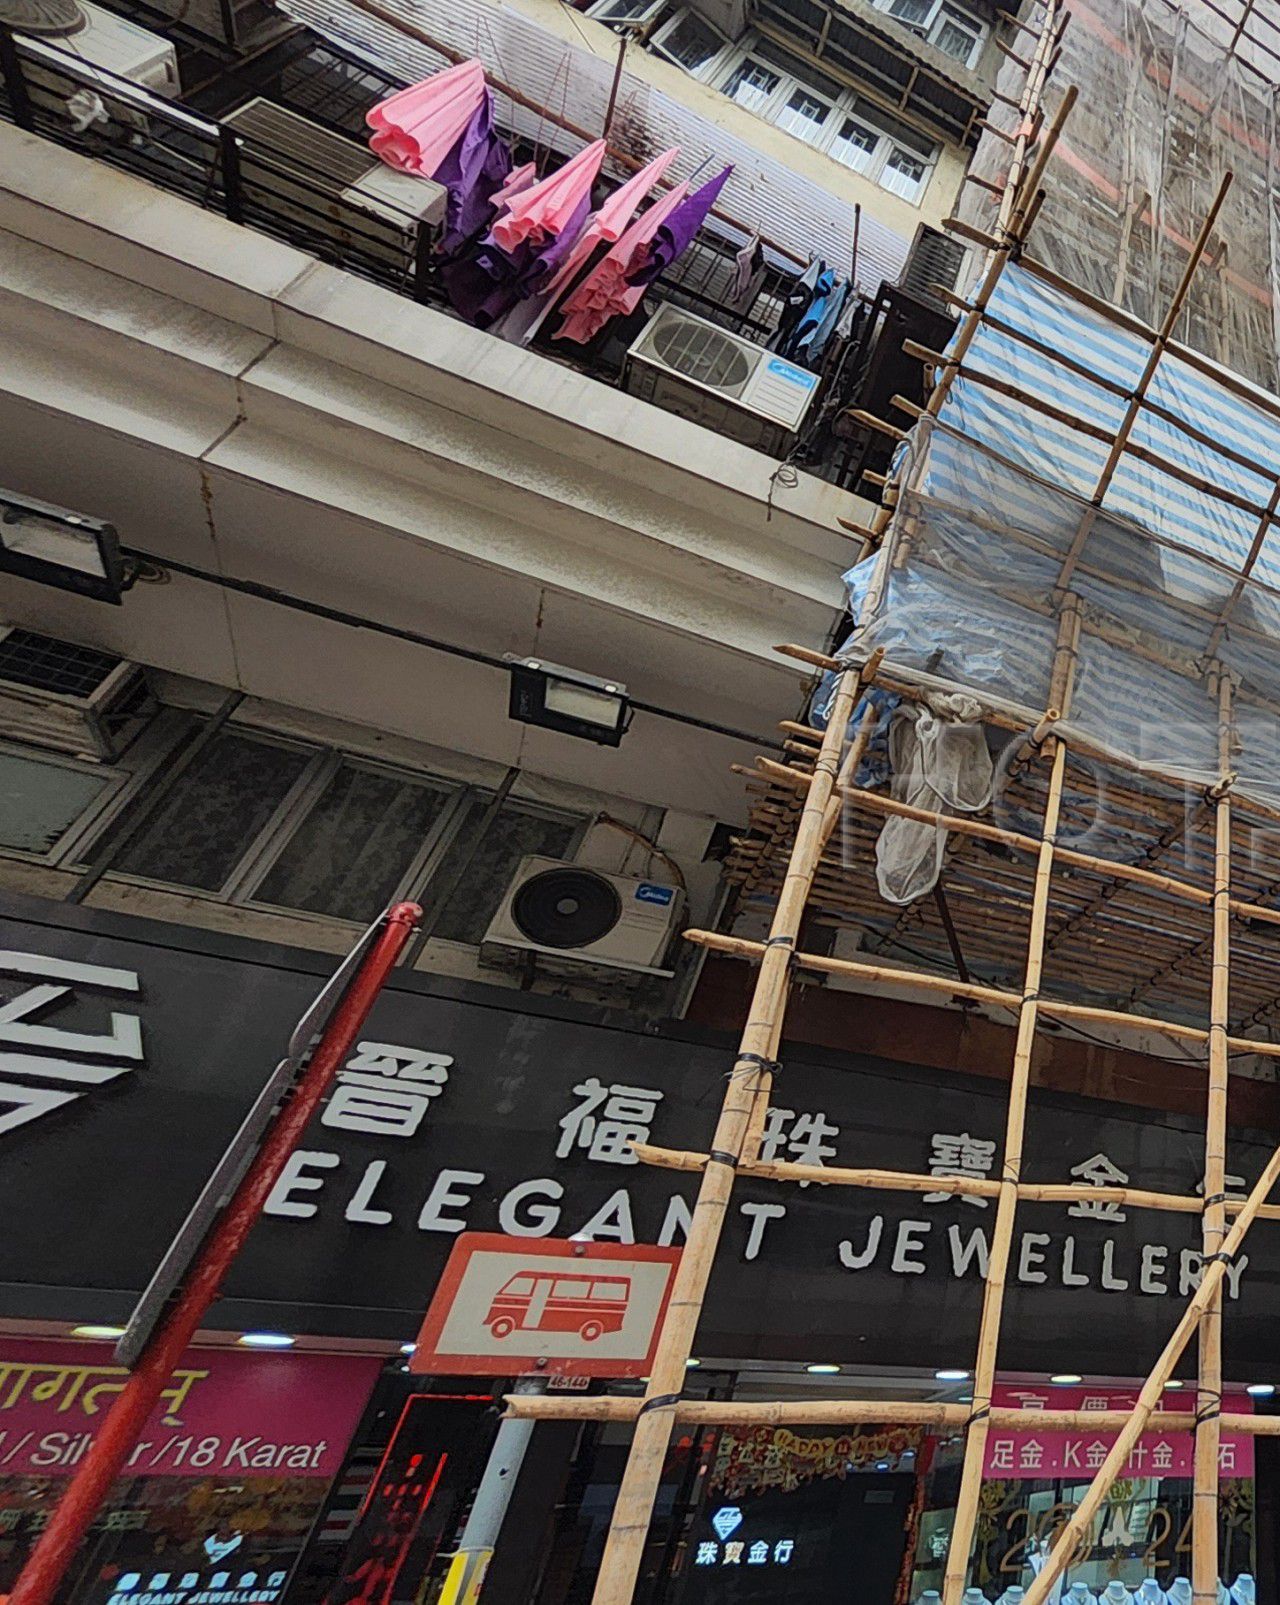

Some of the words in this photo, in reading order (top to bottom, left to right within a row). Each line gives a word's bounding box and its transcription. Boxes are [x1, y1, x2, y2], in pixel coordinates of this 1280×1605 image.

[263, 1149, 786, 1260] ELEGANT
[838, 1215, 1249, 1299] JEWELLERY
[30, 1431, 154, 1467] Silr
[221, 1436, 327, 1468] Karat
[695, 1539, 795, 1565] 珠寶金行
